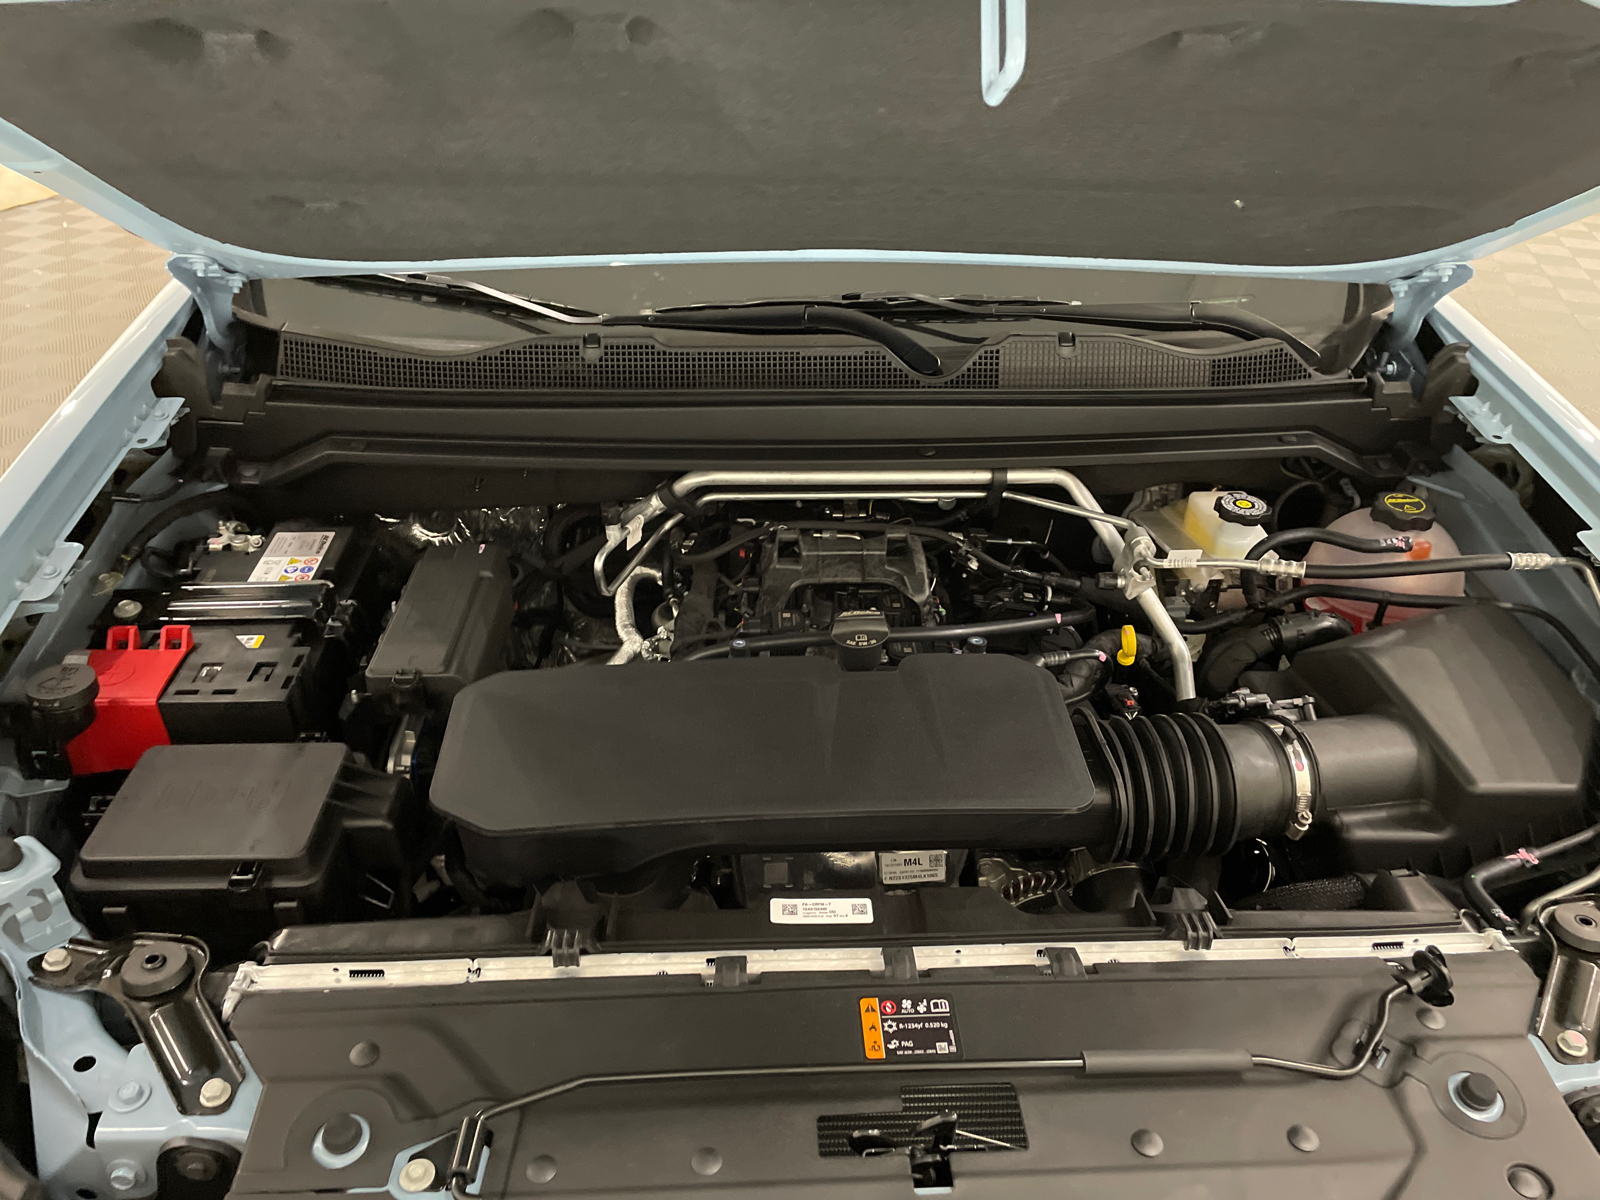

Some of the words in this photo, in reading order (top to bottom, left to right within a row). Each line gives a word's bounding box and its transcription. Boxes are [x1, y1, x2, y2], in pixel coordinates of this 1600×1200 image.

[903, 857, 923, 867] M4L
[940, 1021, 948, 1029] kg
[901, 1040, 914, 1048] PAG
